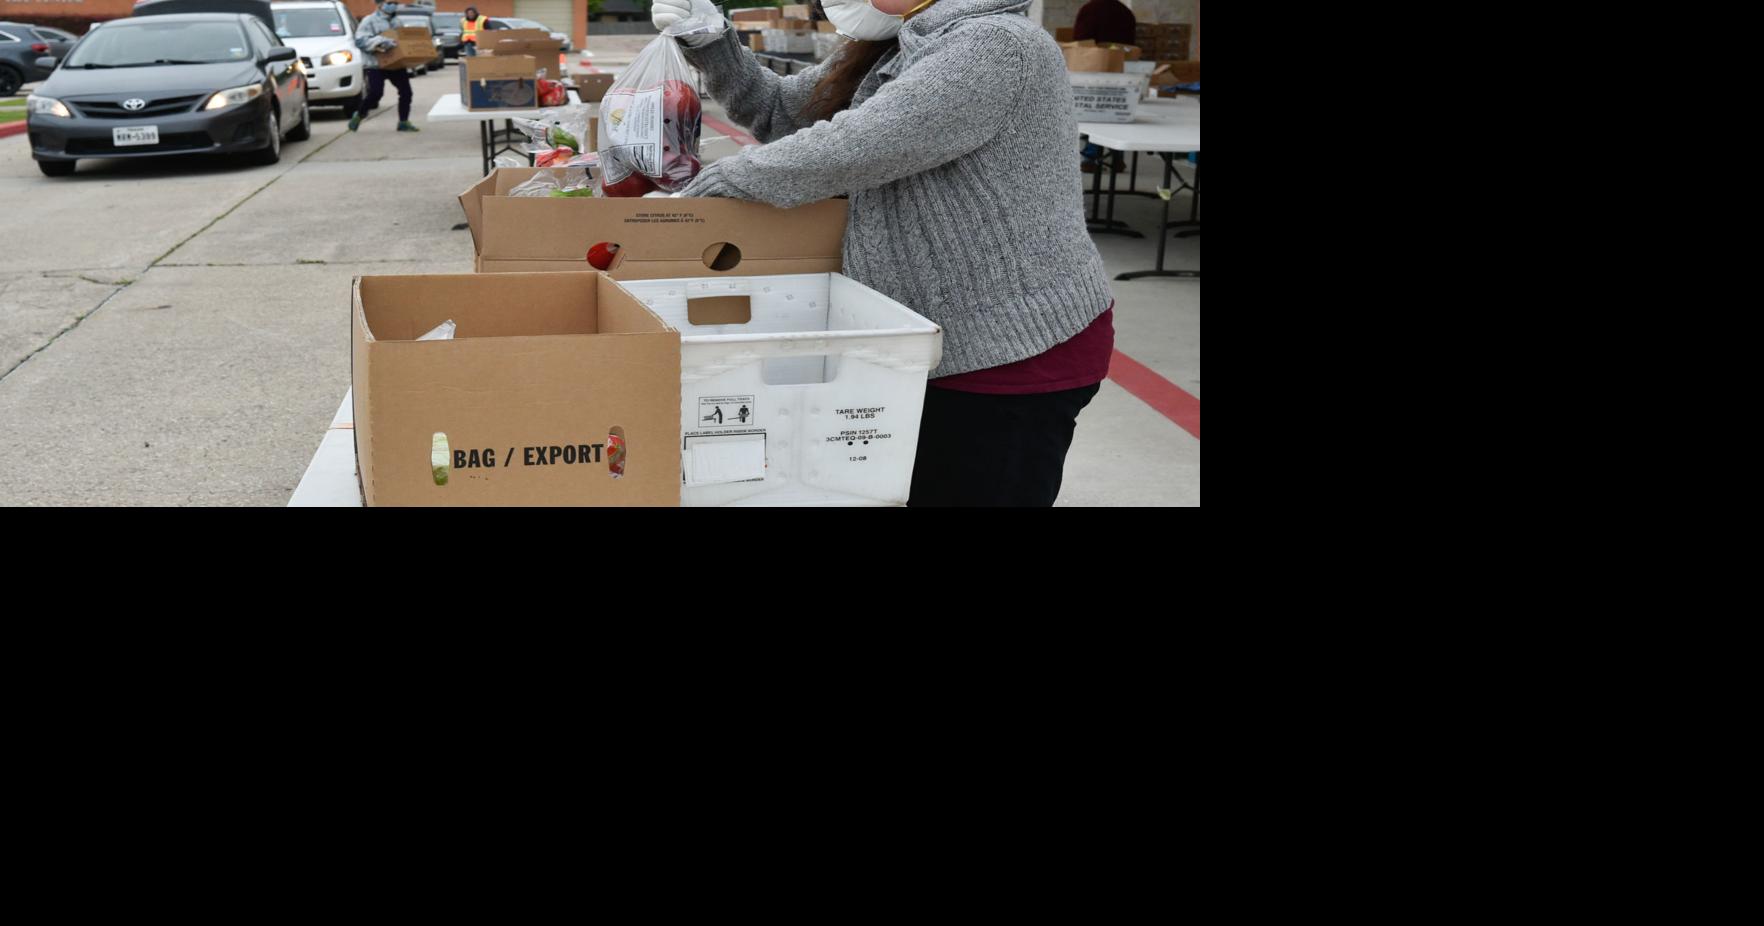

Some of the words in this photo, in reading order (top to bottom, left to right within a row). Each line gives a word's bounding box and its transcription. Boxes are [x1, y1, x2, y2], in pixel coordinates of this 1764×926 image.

[856, 406, 885, 414] WEIGHT
[453, 448, 496, 469] BAG
[504, 447, 515, 467] /
[523, 444, 604, 466] EXPORT
